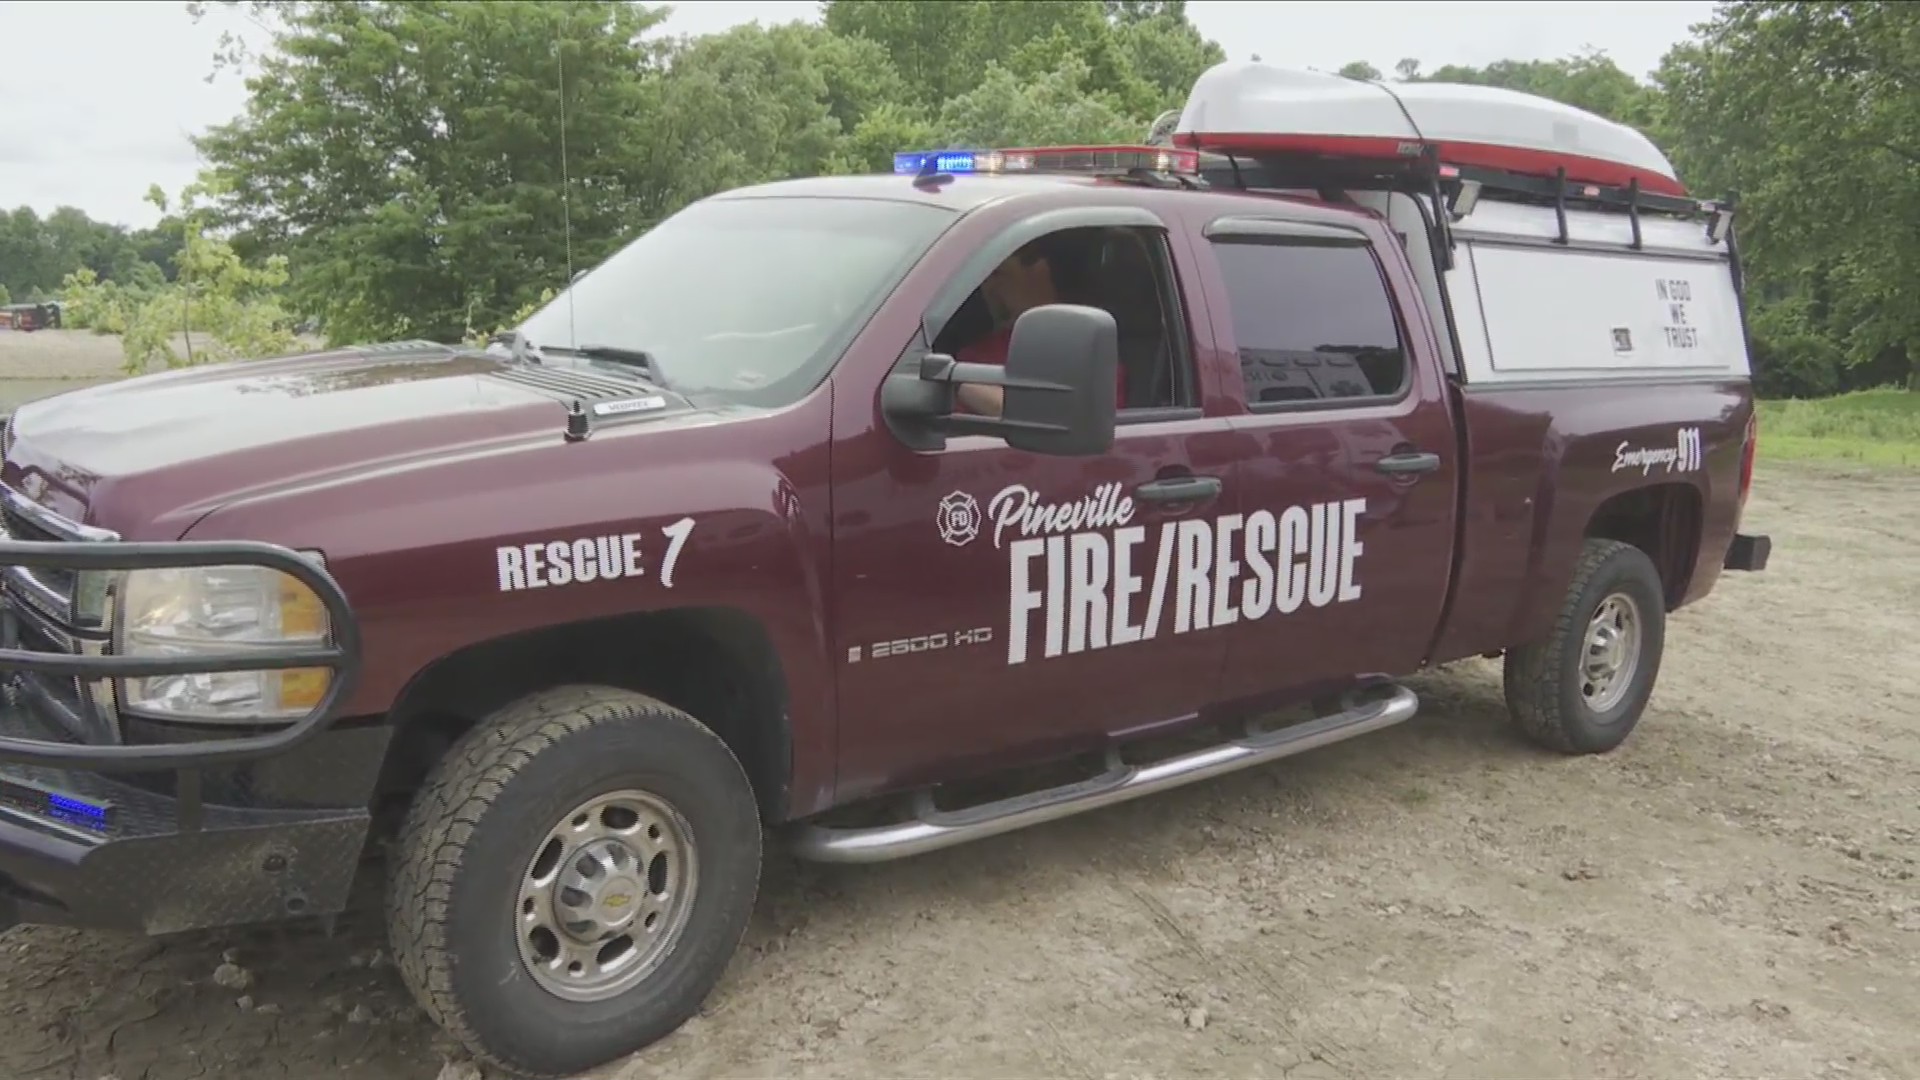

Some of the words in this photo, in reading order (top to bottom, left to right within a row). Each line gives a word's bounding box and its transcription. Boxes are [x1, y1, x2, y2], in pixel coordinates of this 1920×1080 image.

[1655, 279, 1668, 300] IN
[1669, 280, 1691, 301] GOD
[1669, 303, 1687, 325] WE
[1664, 326, 1698, 348] TRUST
[1611, 440, 1677, 476] Emergency
[1677, 427, 1700, 472] 911
[988, 481, 1136, 549] Pineville
[497, 533, 644, 591] RESCUE
[660, 517, 696, 588] 1
[1008, 498, 1366, 665] FIRE/RESCUE
[872, 633, 947, 658] 2500
[954, 627, 992, 646] HD
